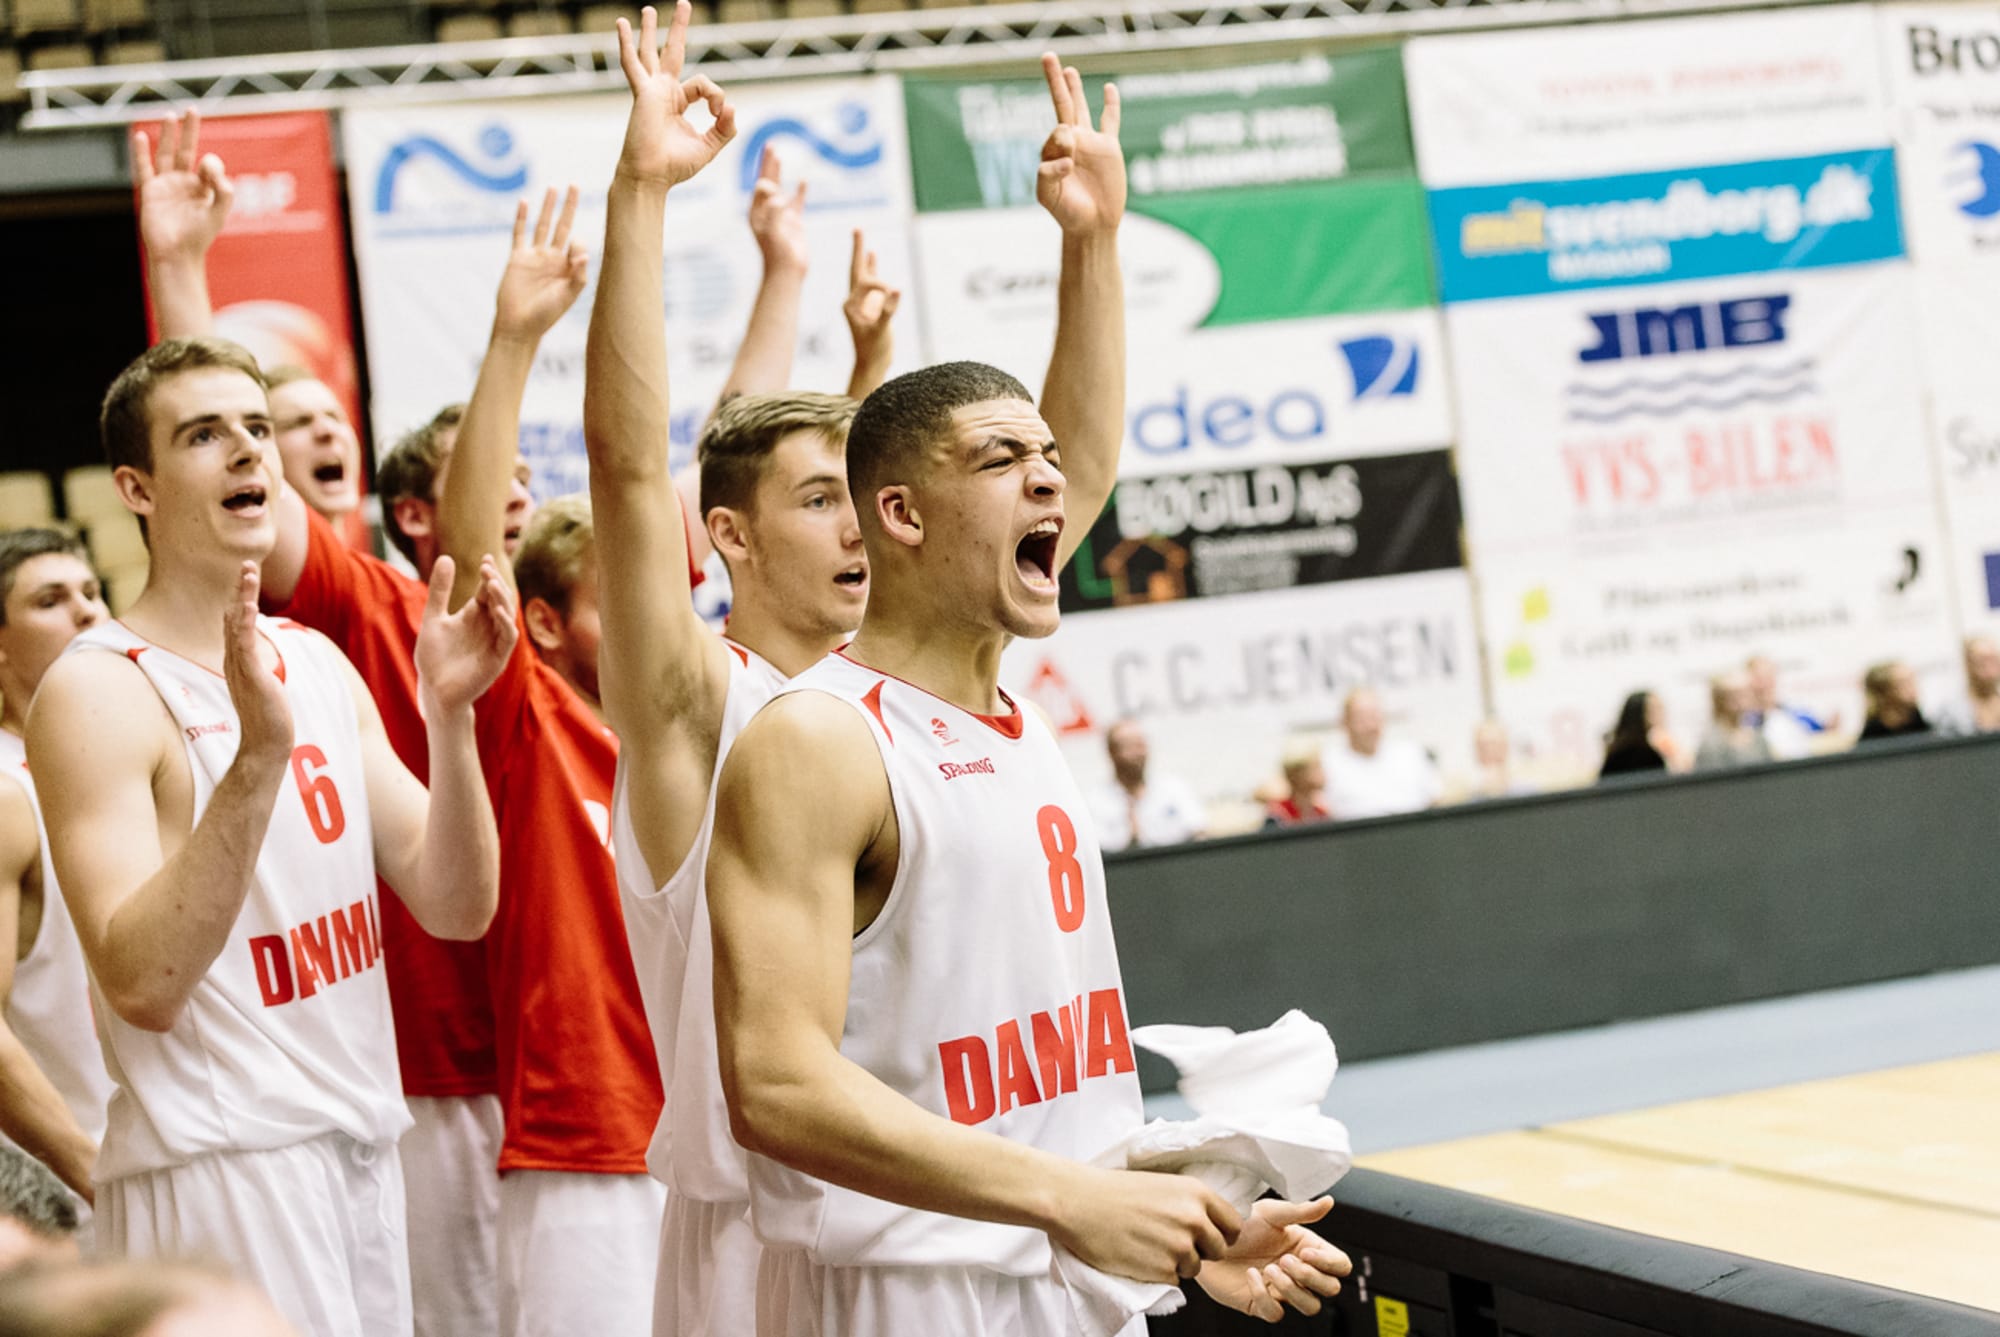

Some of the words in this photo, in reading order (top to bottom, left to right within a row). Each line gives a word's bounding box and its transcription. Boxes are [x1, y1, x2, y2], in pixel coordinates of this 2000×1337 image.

[291, 744, 346, 844] 6
[938, 757, 996, 781] SPALDING
[1036, 804, 1085, 933] 8
